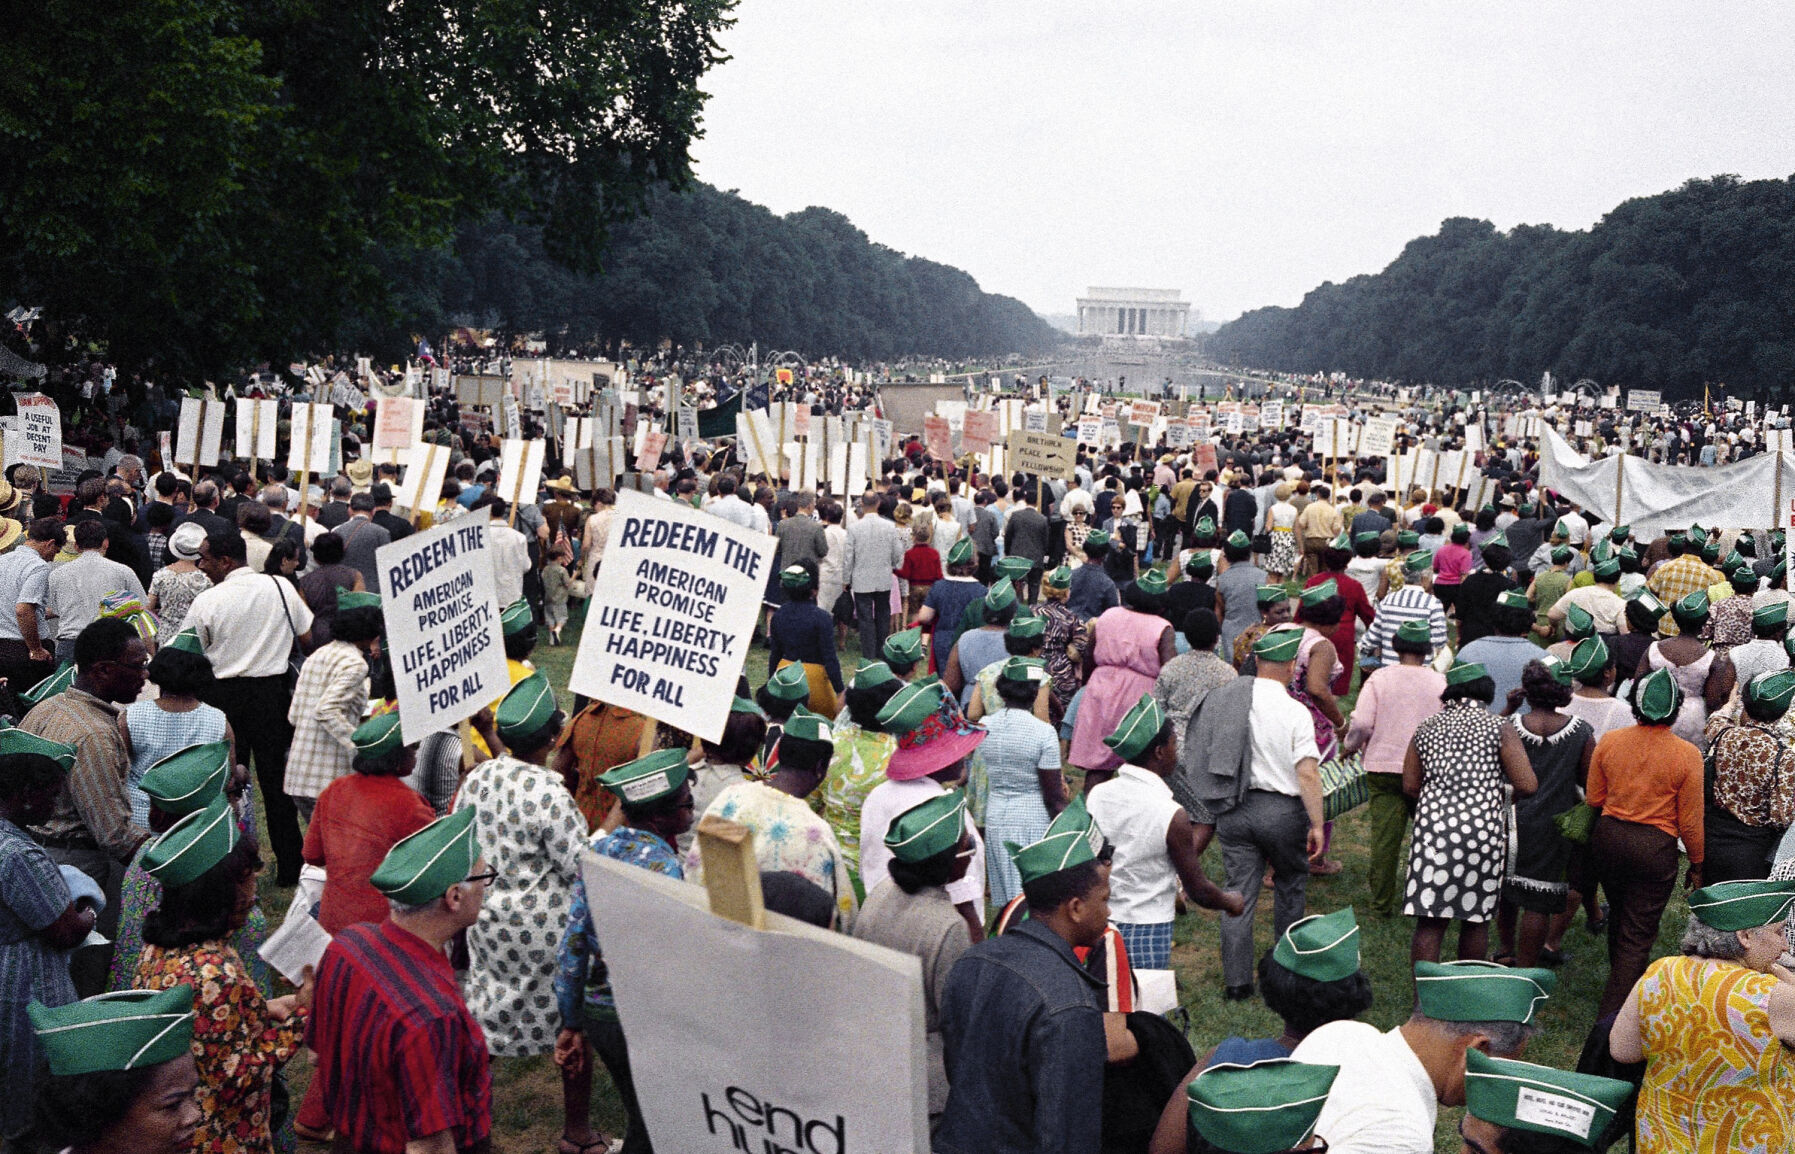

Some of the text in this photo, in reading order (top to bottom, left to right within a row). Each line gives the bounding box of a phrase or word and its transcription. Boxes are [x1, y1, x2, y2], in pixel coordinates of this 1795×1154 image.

[25, 412, 53, 425] A USEFUL
[26, 423, 39, 432] JOB
[26, 432, 51, 443] DECENT
[34, 443, 47, 453] PAY
[1019, 447, 1041, 458] PEACE
[1027, 436, 1062, 448] BRETHREN
[1021, 461, 1065, 473] FELLOWSHIP
[389, 525, 484, 598] REDEEM THE
[620, 518, 761, 580] REDEEM THE
[413, 569, 474, 612] AMERICAN
[635, 581, 716, 623] PROMISE
[636, 559, 728, 604] AMERICAN
[419, 592, 474, 632] PROMISE
[416, 628, 491, 692] HAPPINESS
[606, 633, 720, 678] HAPPINESS
[429, 672, 484, 714] FOR ALL
[610, 663, 684, 708] FOR ALL
